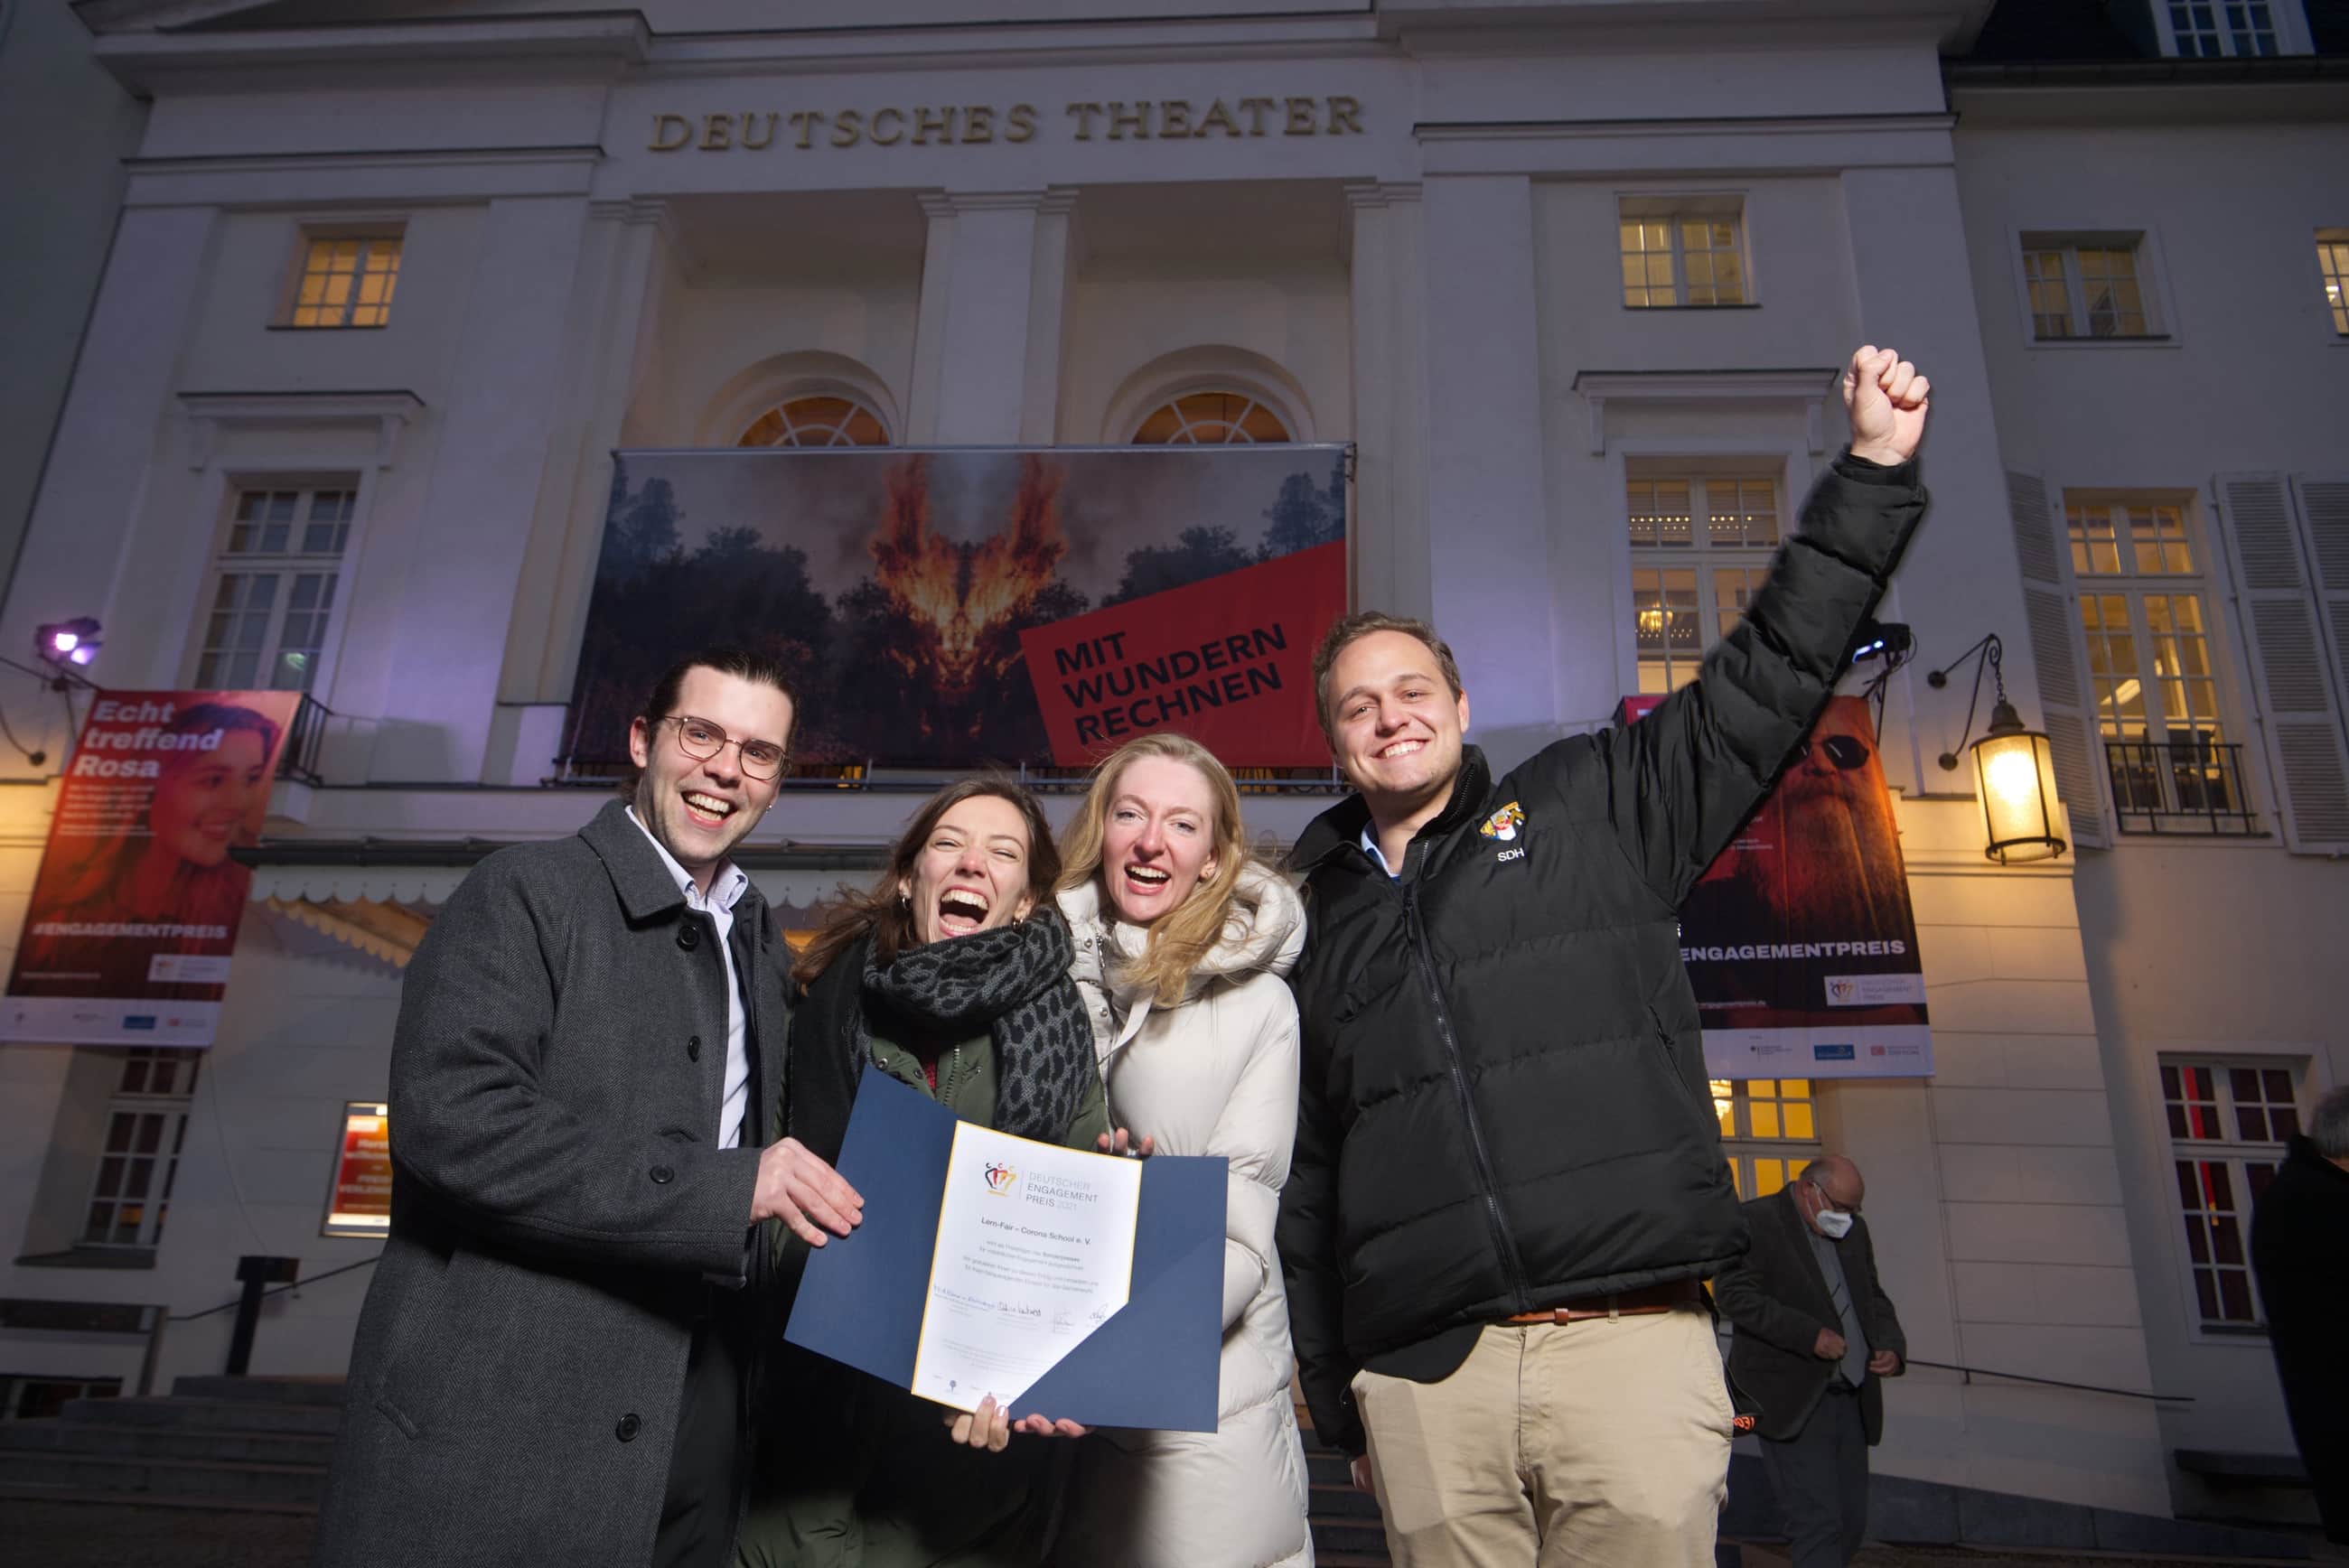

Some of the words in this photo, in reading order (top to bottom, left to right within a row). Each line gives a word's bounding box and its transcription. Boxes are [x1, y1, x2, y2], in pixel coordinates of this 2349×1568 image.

[646, 101, 1039, 153] DEUTSCHES
[1064, 94, 1365, 140] THEATER
[1054, 631, 1127, 677] MIT
[1062, 622, 1287, 709] WUNDERN
[93, 700, 175, 723] Echt
[1074, 662, 1282, 745] RECHNEN
[84, 726, 225, 751] treffend
[72, 753, 161, 778] Rosa
[1497, 847, 1525, 862] SDH
[32, 921, 228, 939] #ENGAGEMENTPREIS
[1029, 1171, 1091, 1190] DEUTSCHER
[1025, 1193, 1055, 1208] PREIS
[1026, 1182, 1099, 1203] ENGAGEMENT
[1021, 1227, 1048, 1239] Corona
[1049, 1232, 1075, 1243] School
